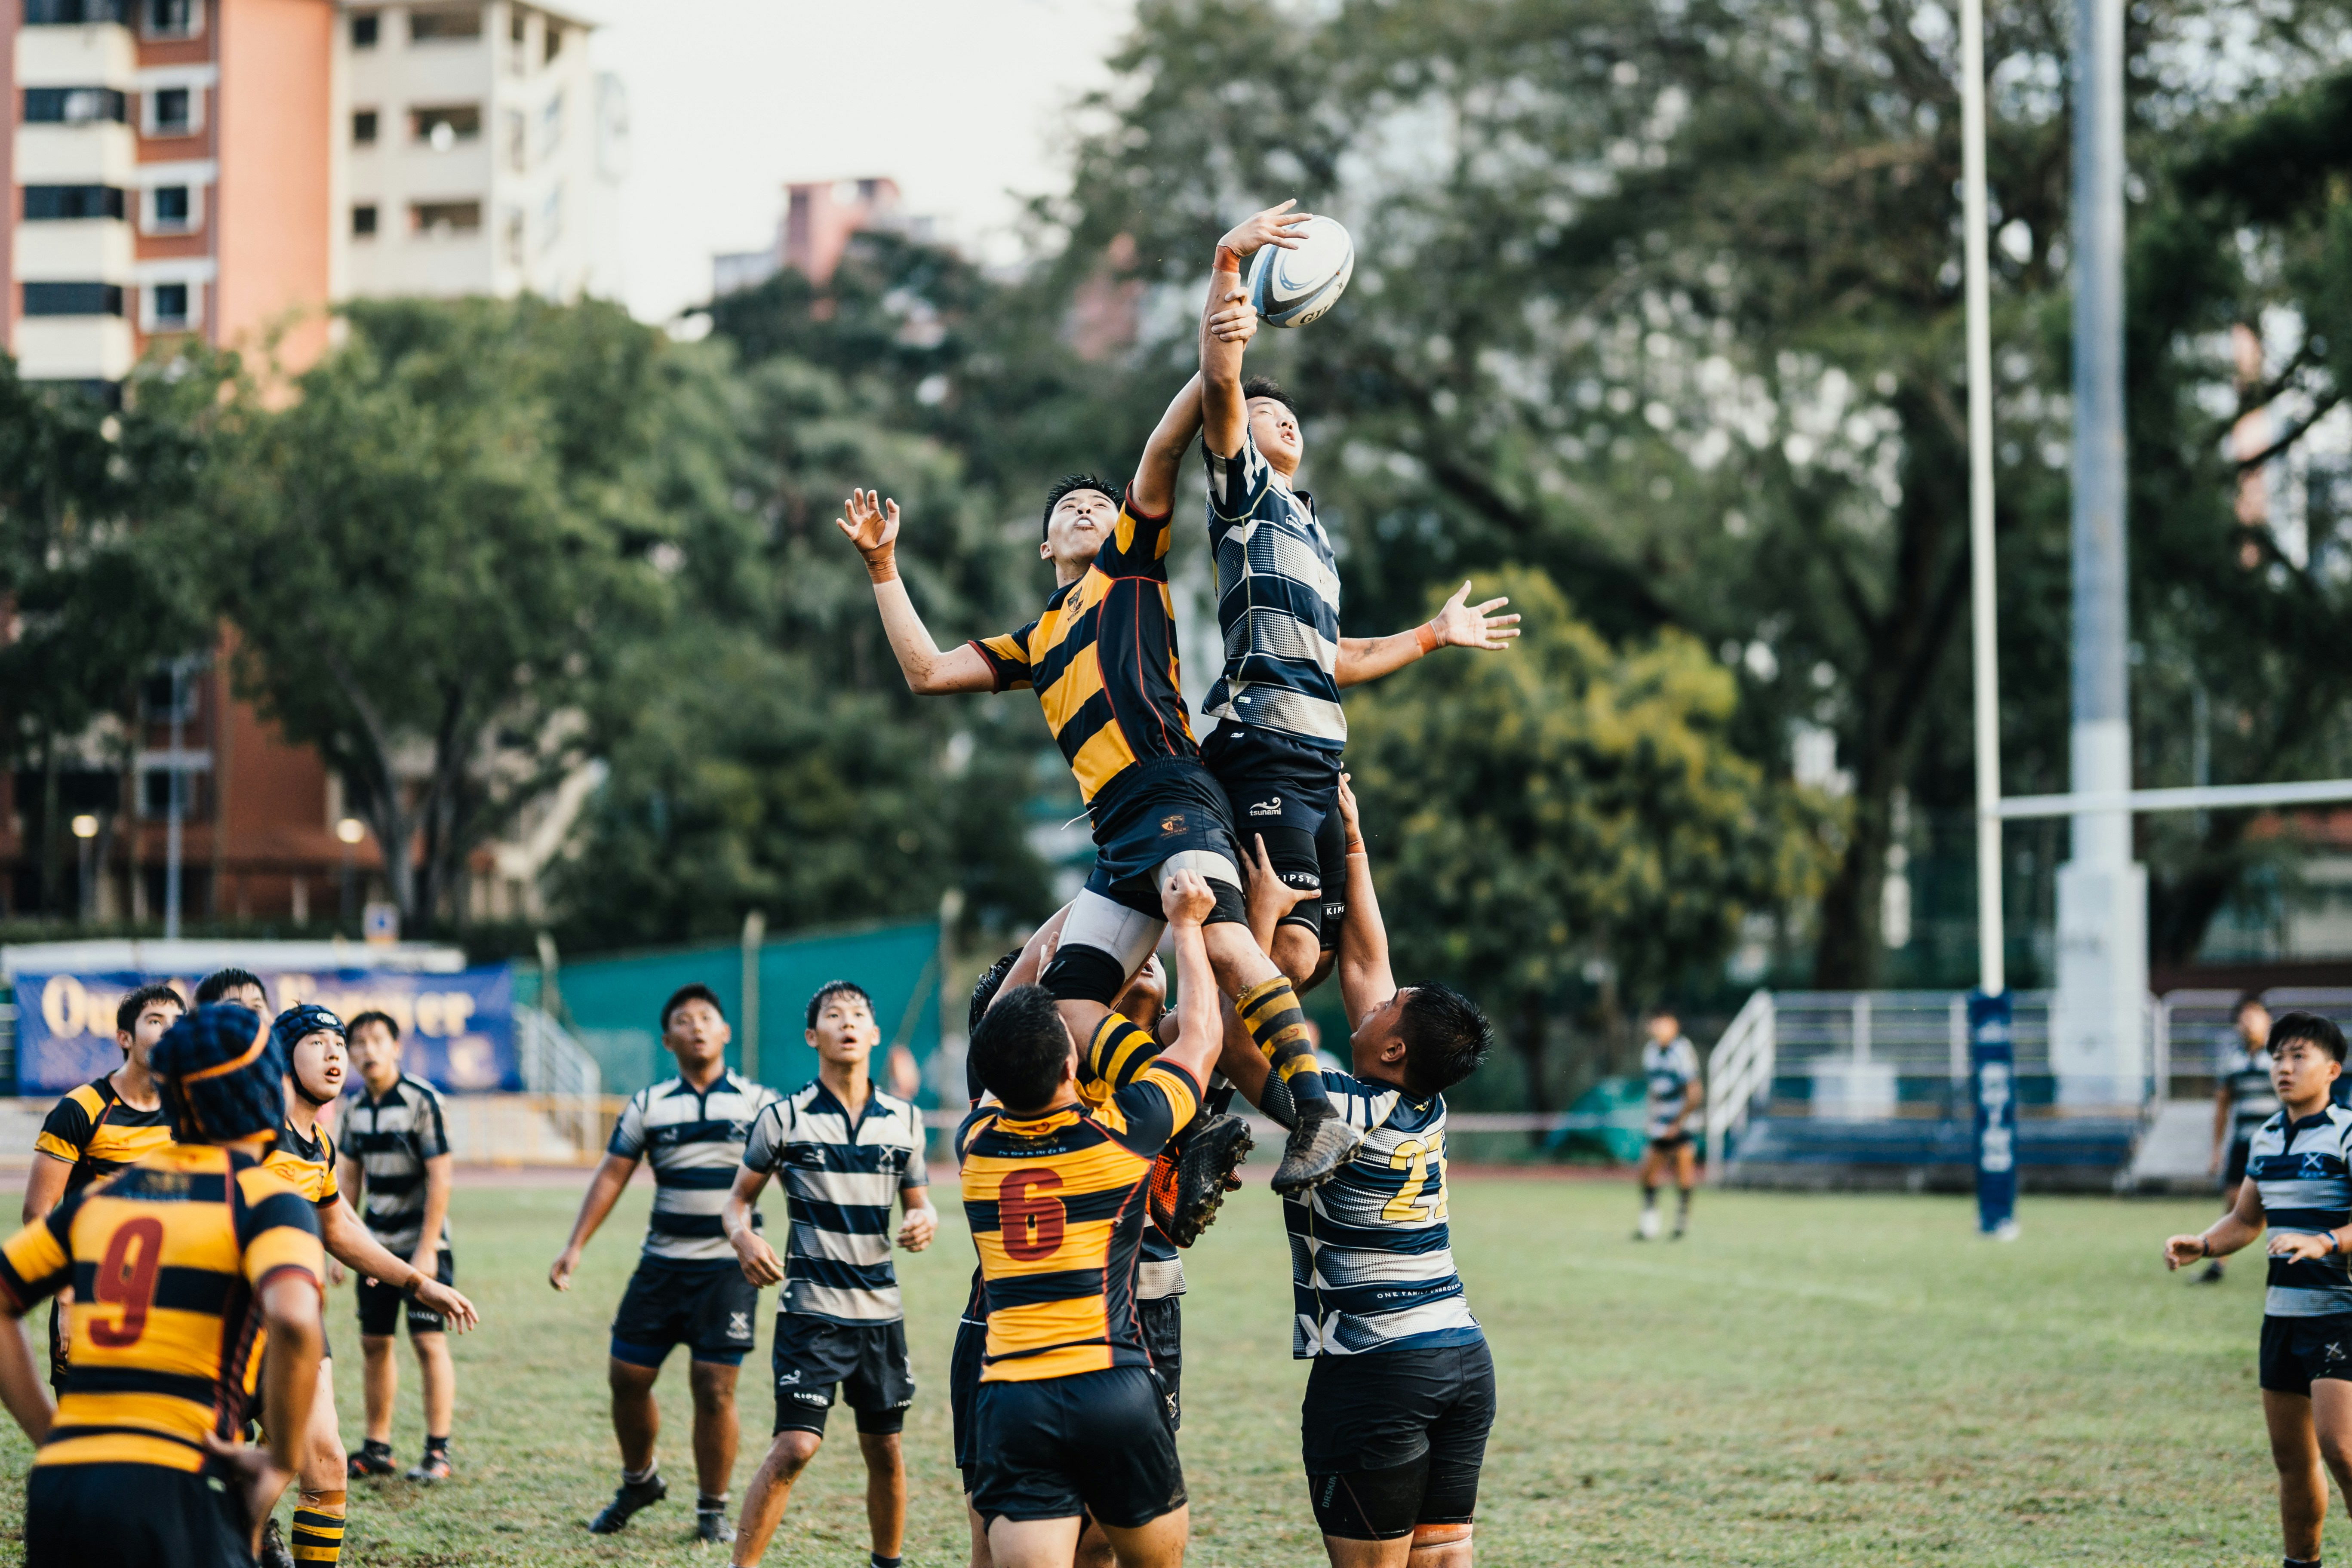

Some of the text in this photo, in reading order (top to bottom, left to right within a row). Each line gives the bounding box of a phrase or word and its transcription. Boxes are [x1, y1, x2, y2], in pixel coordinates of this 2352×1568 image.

[1276, 874, 1318, 886] IPSTA
[1326, 906, 1344, 915] KIPS
[998, 1168, 1066, 1262] 6
[89, 1216, 163, 1347] 9
[1322, 1475, 1337, 1508] DRSKIN
